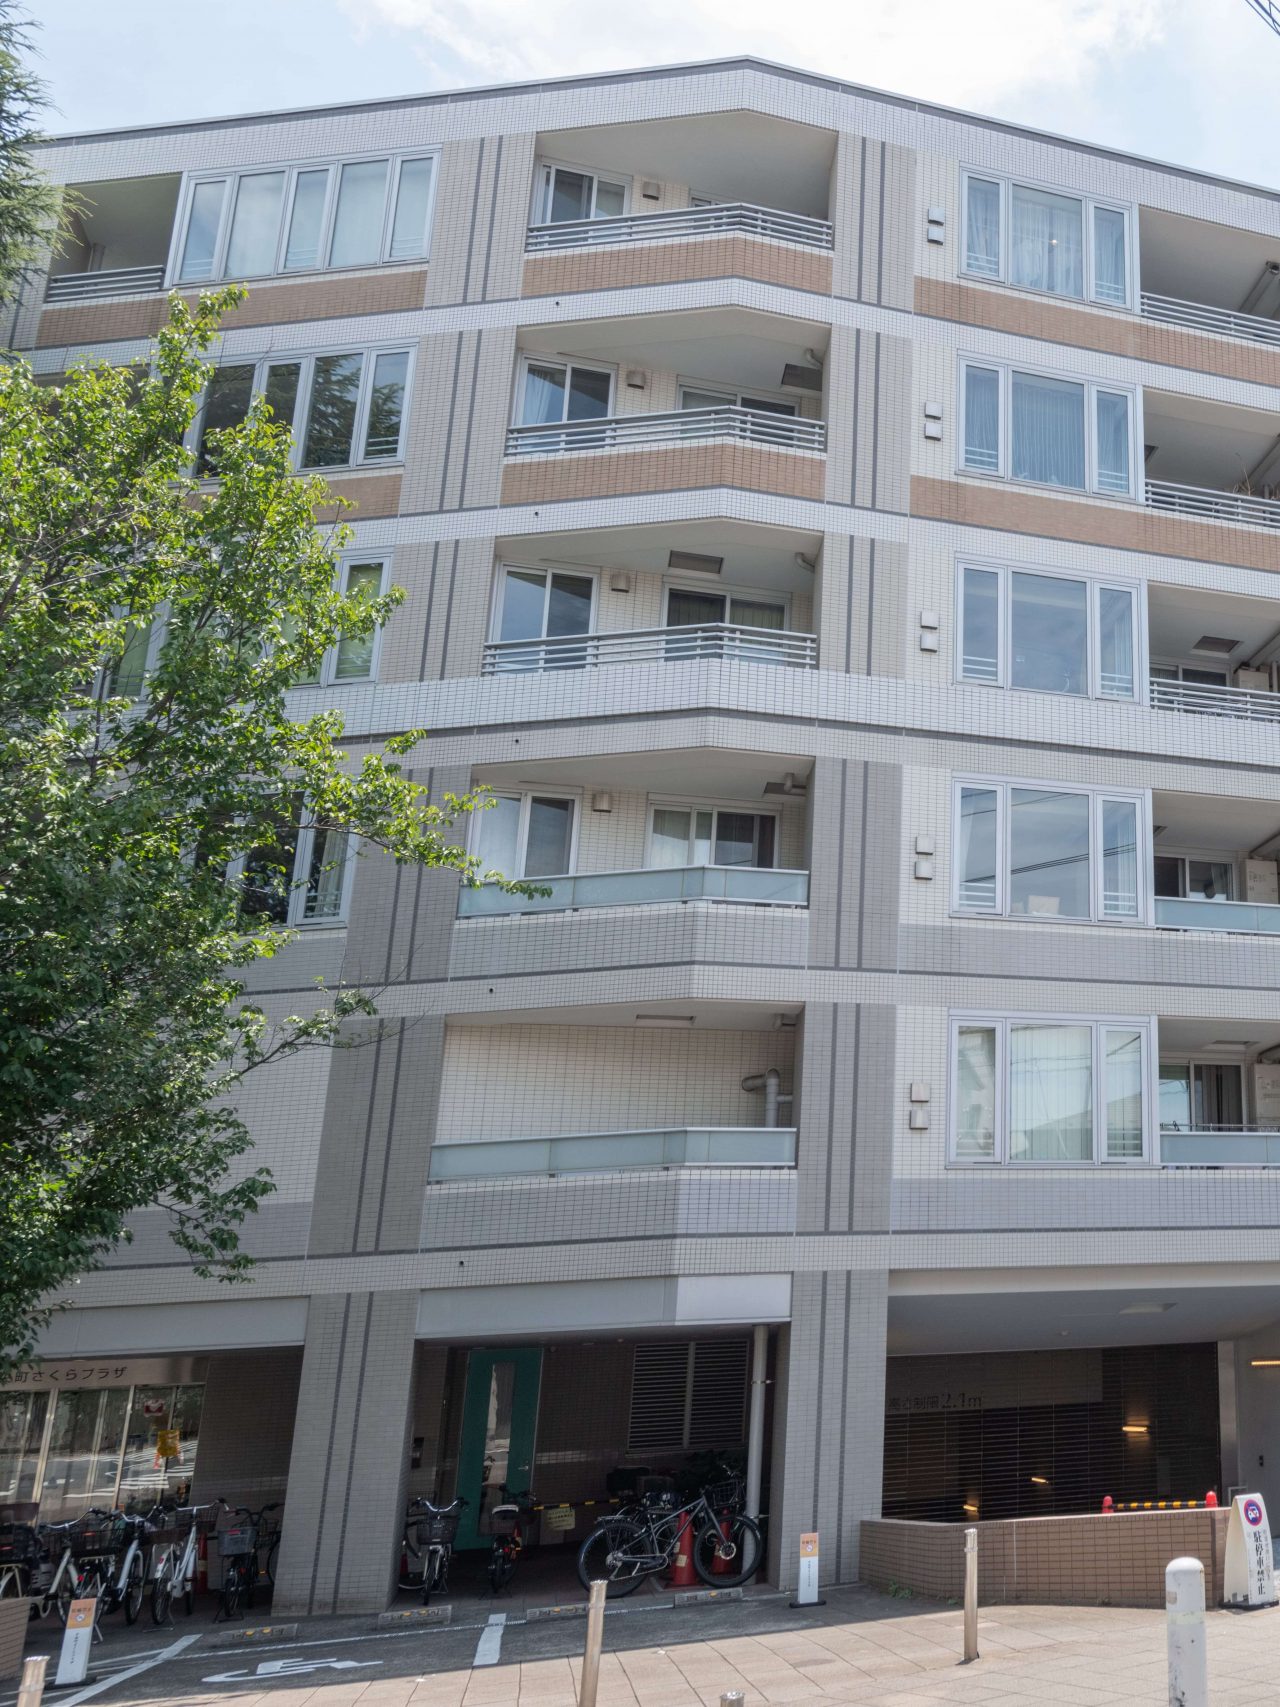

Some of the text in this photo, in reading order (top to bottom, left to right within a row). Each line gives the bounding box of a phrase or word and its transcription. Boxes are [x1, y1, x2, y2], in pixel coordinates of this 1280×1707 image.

[1253, 1530, 1266, 1595] 駐停車禁止
